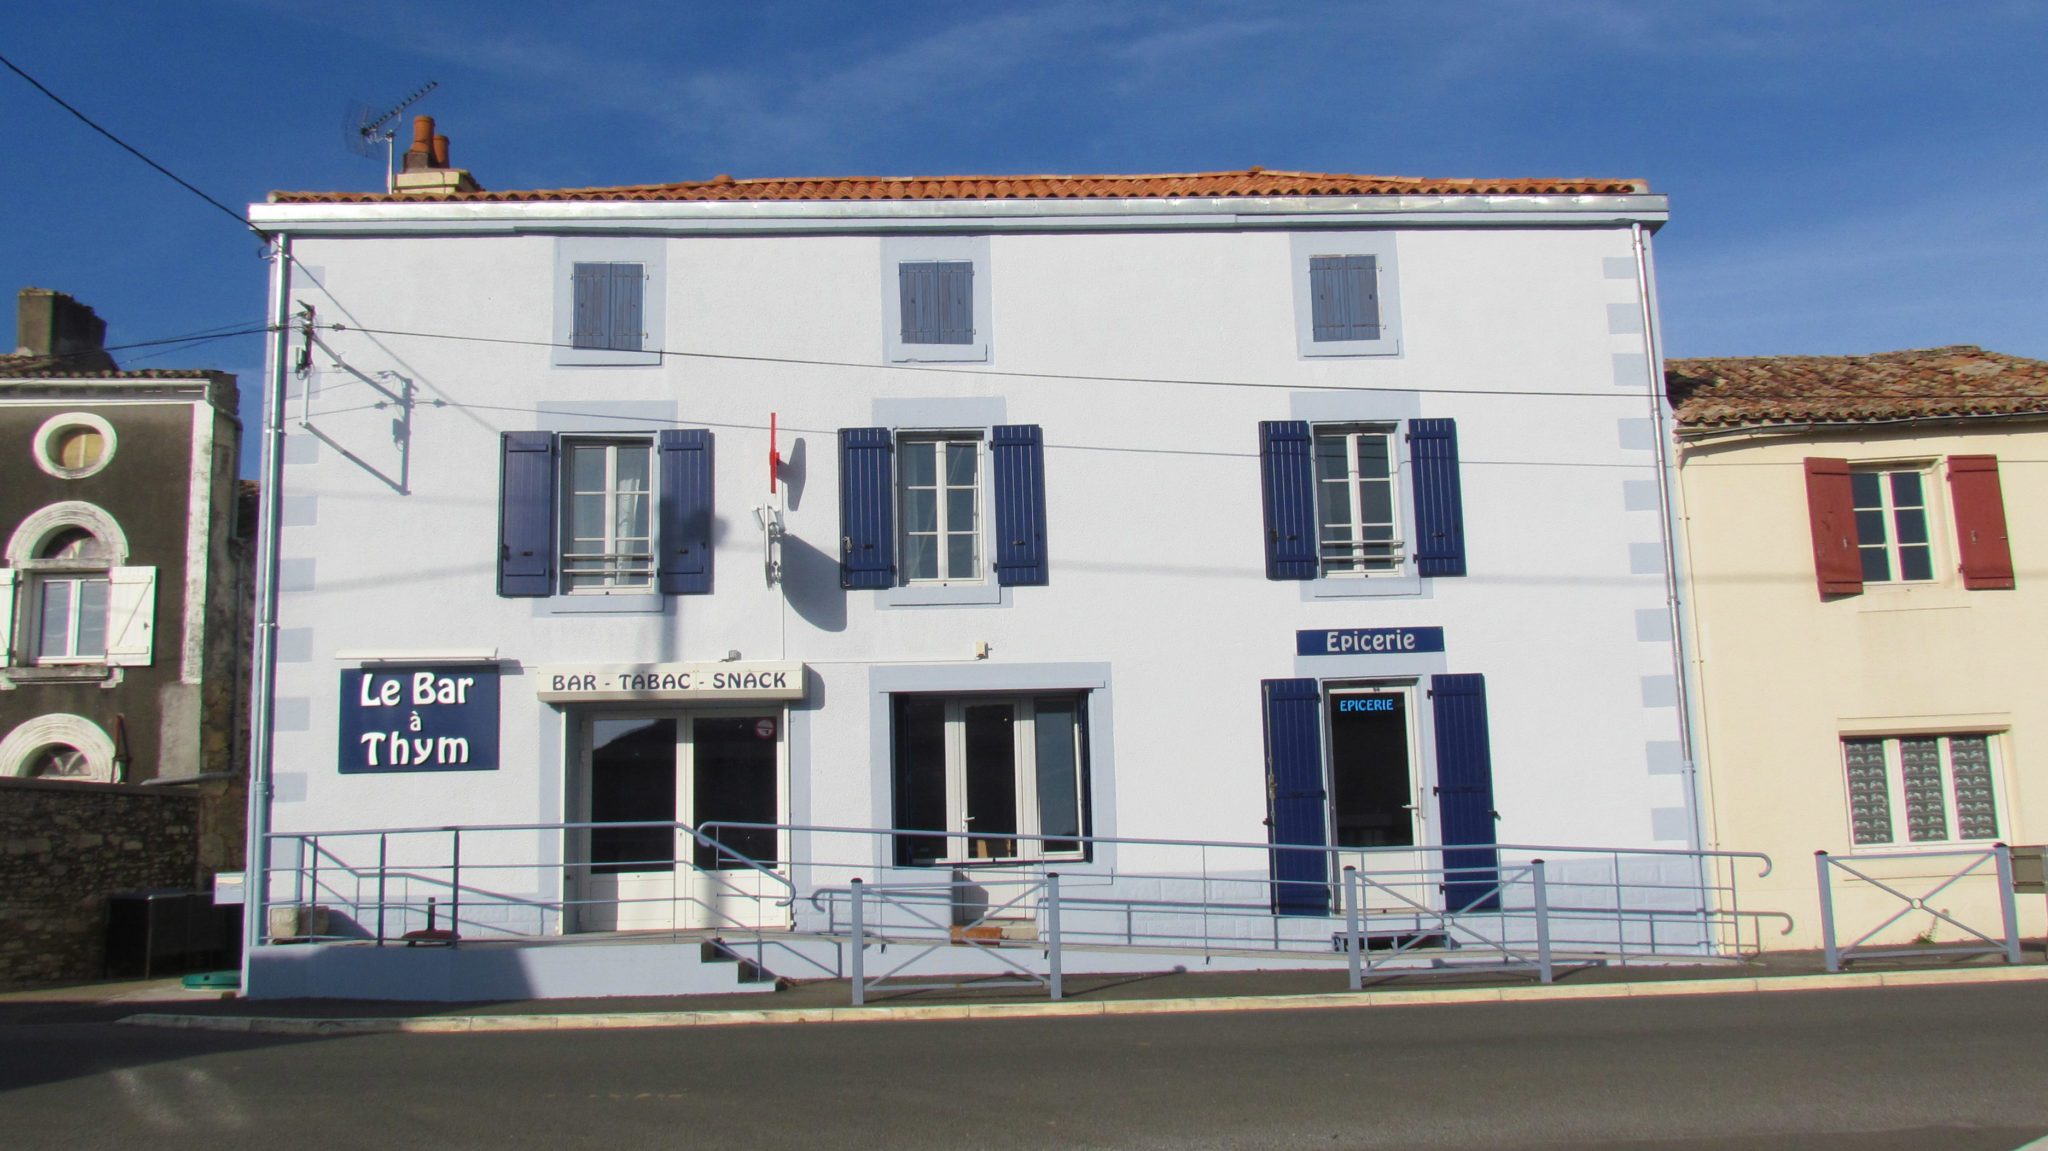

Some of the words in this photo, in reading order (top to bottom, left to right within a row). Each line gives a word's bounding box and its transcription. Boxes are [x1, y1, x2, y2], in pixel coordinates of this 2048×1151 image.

[1326, 629, 1416, 652] Epicerie
[360, 673, 401, 707] Le
[412, 672, 475, 705] Bar
[552, 674, 597, 691] BAR
[618, 673, 691, 690] TABAC
[712, 672, 787, 689] SNACK
[1340, 698, 1395, 712] EPICERIE
[409, 710, 422, 732] à
[360, 731, 469, 766] Thym
